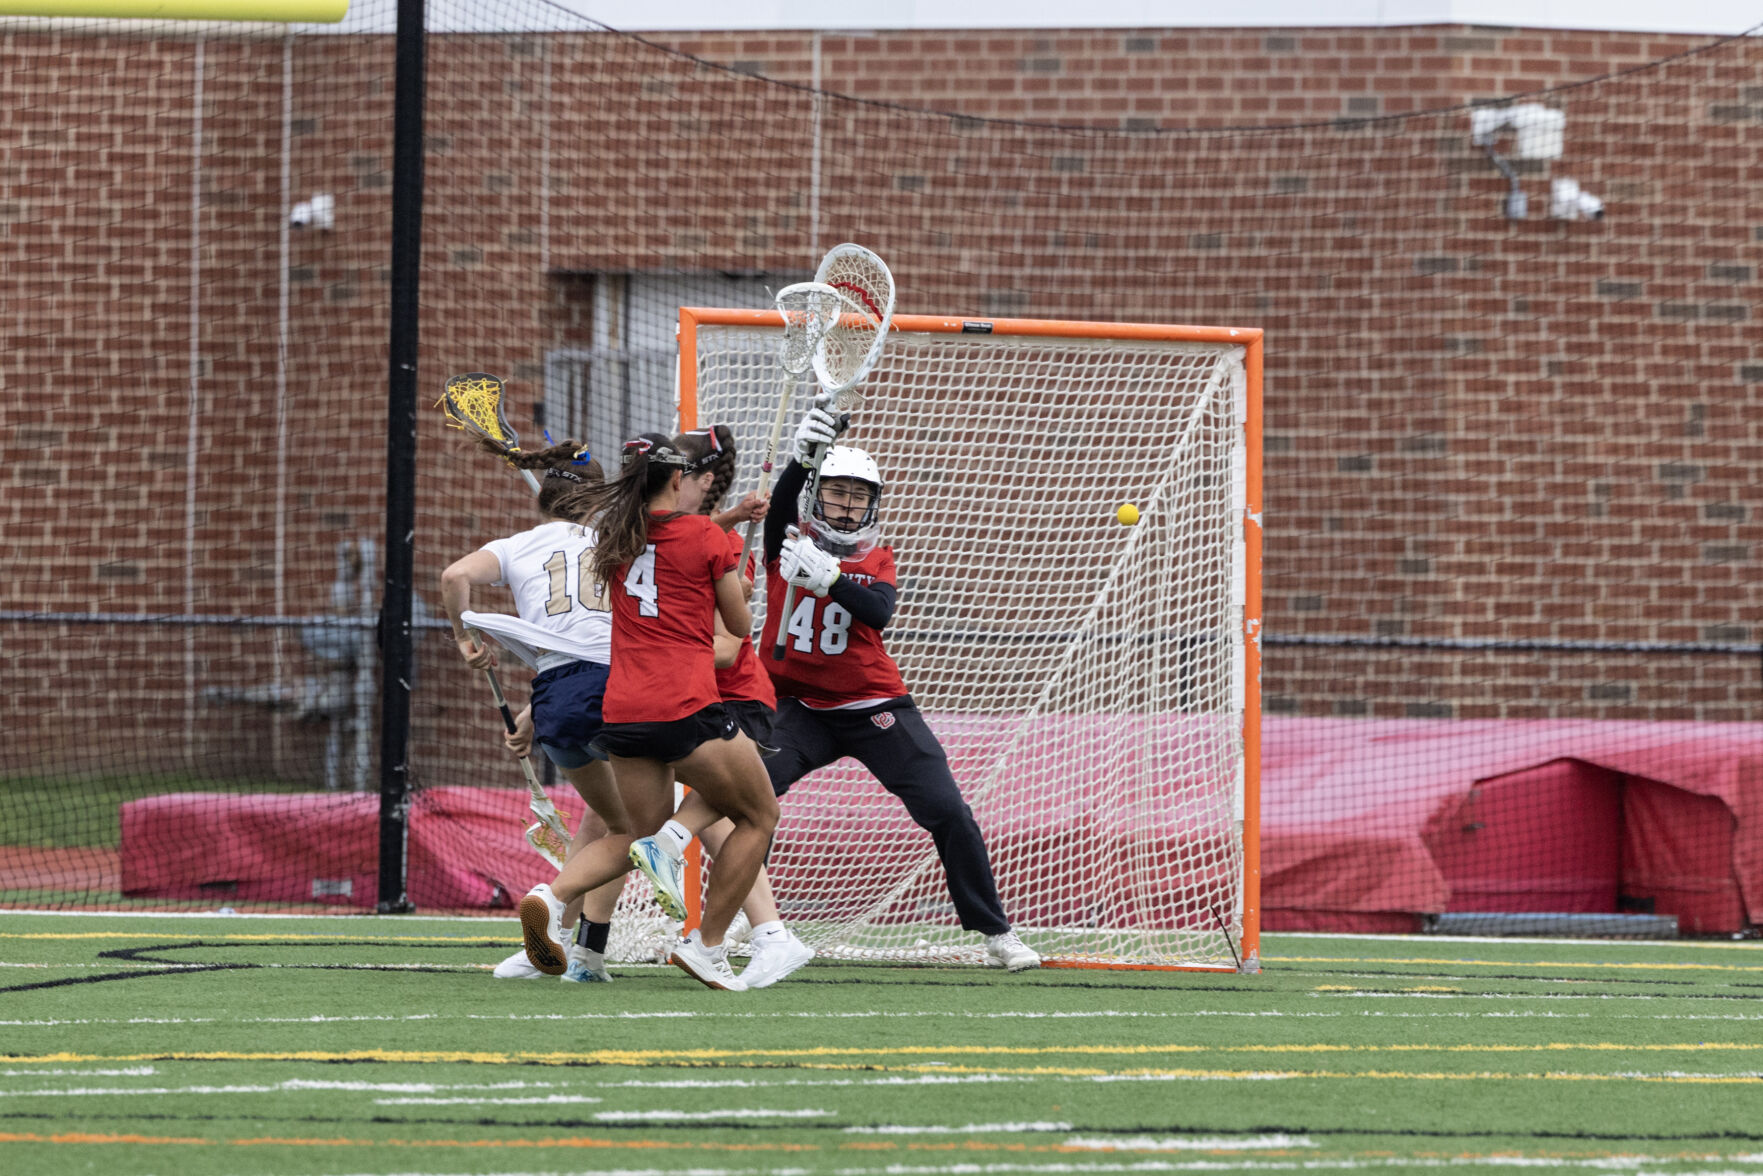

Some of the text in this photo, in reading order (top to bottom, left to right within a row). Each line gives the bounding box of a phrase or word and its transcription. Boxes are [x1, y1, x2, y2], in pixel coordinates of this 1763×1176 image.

[623, 544, 660, 618] 4
[841, 572, 876, 586] ITY
[788, 596, 852, 656] 48
